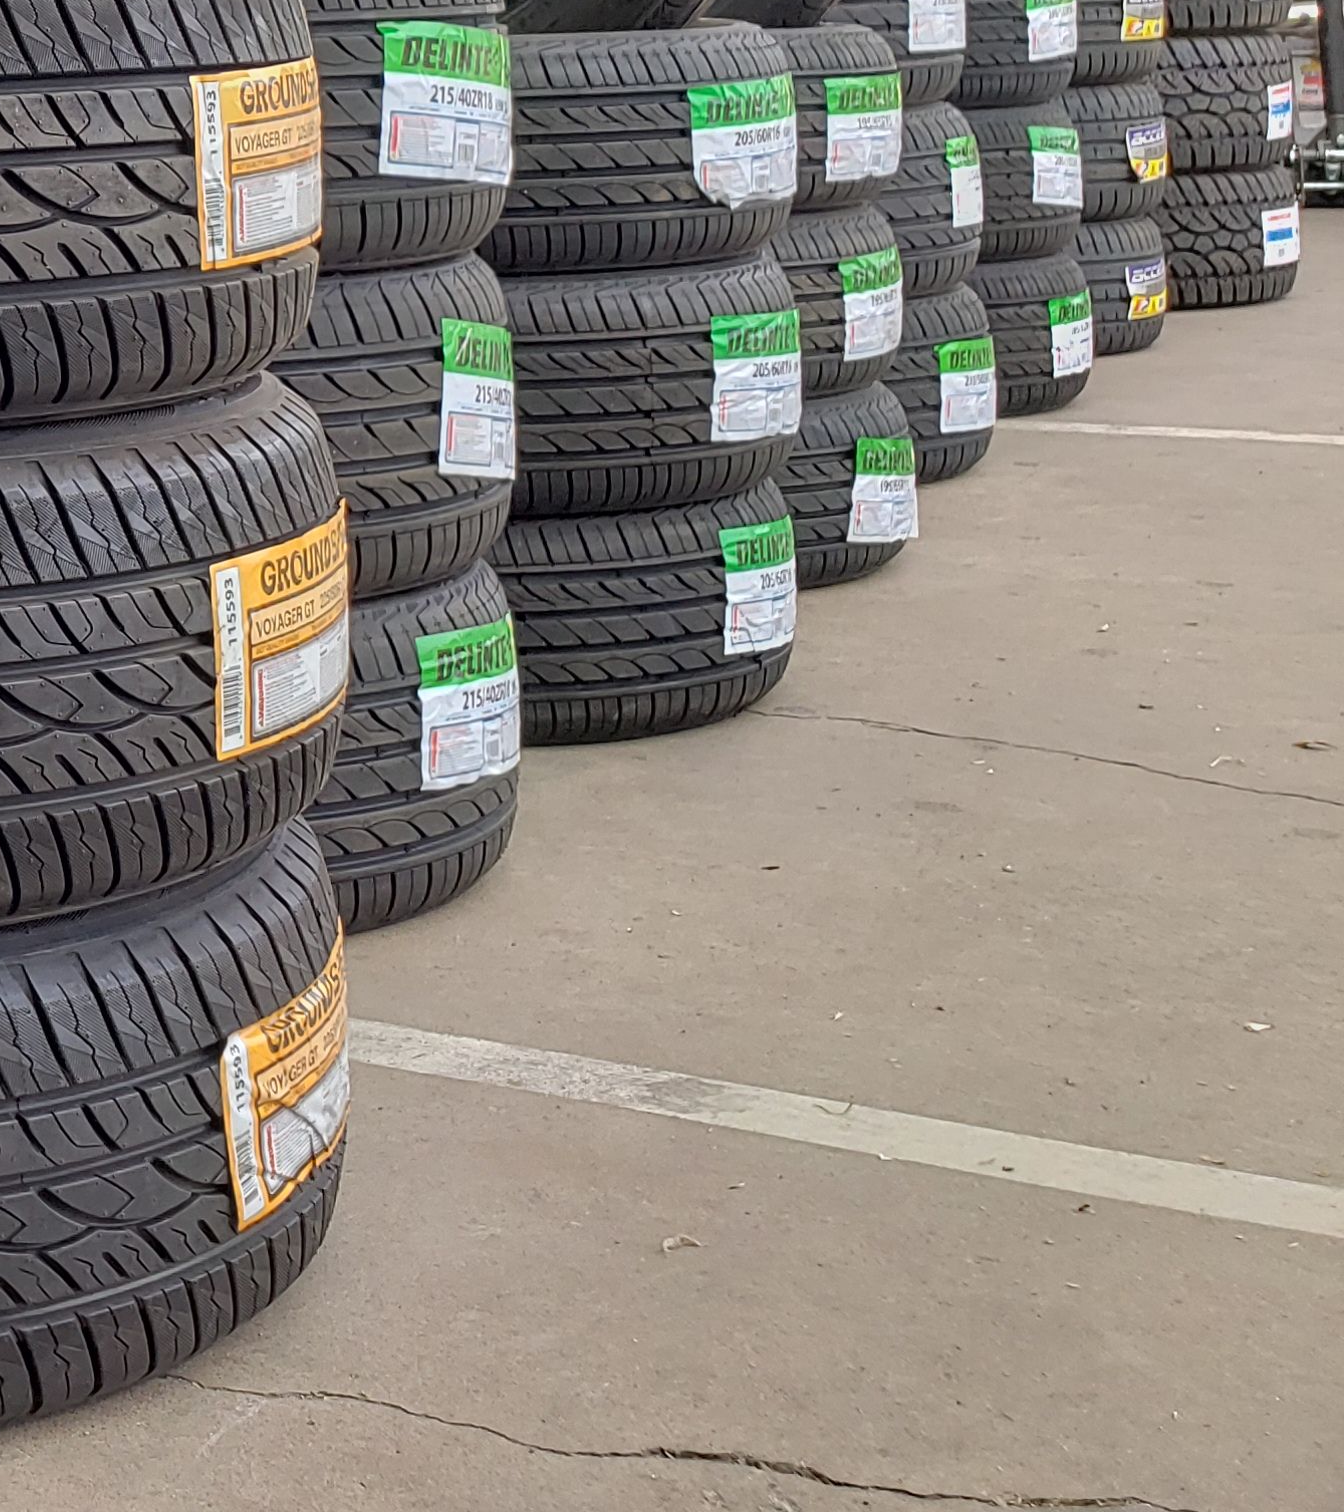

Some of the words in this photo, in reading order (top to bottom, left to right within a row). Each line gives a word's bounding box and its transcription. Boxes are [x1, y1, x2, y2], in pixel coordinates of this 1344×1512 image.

[401, 37, 492, 76] DELINTE
[430, 85, 493, 110] 215/40ZR18
[235, 130, 280, 154] VOYAGER
[282, 128, 292, 146] GT
[735, 126, 780, 147] 205/60R16
[224, 577, 238, 647] 115593
[255, 605, 303, 638] VOYAGER
[304, 599, 315, 619] GT
